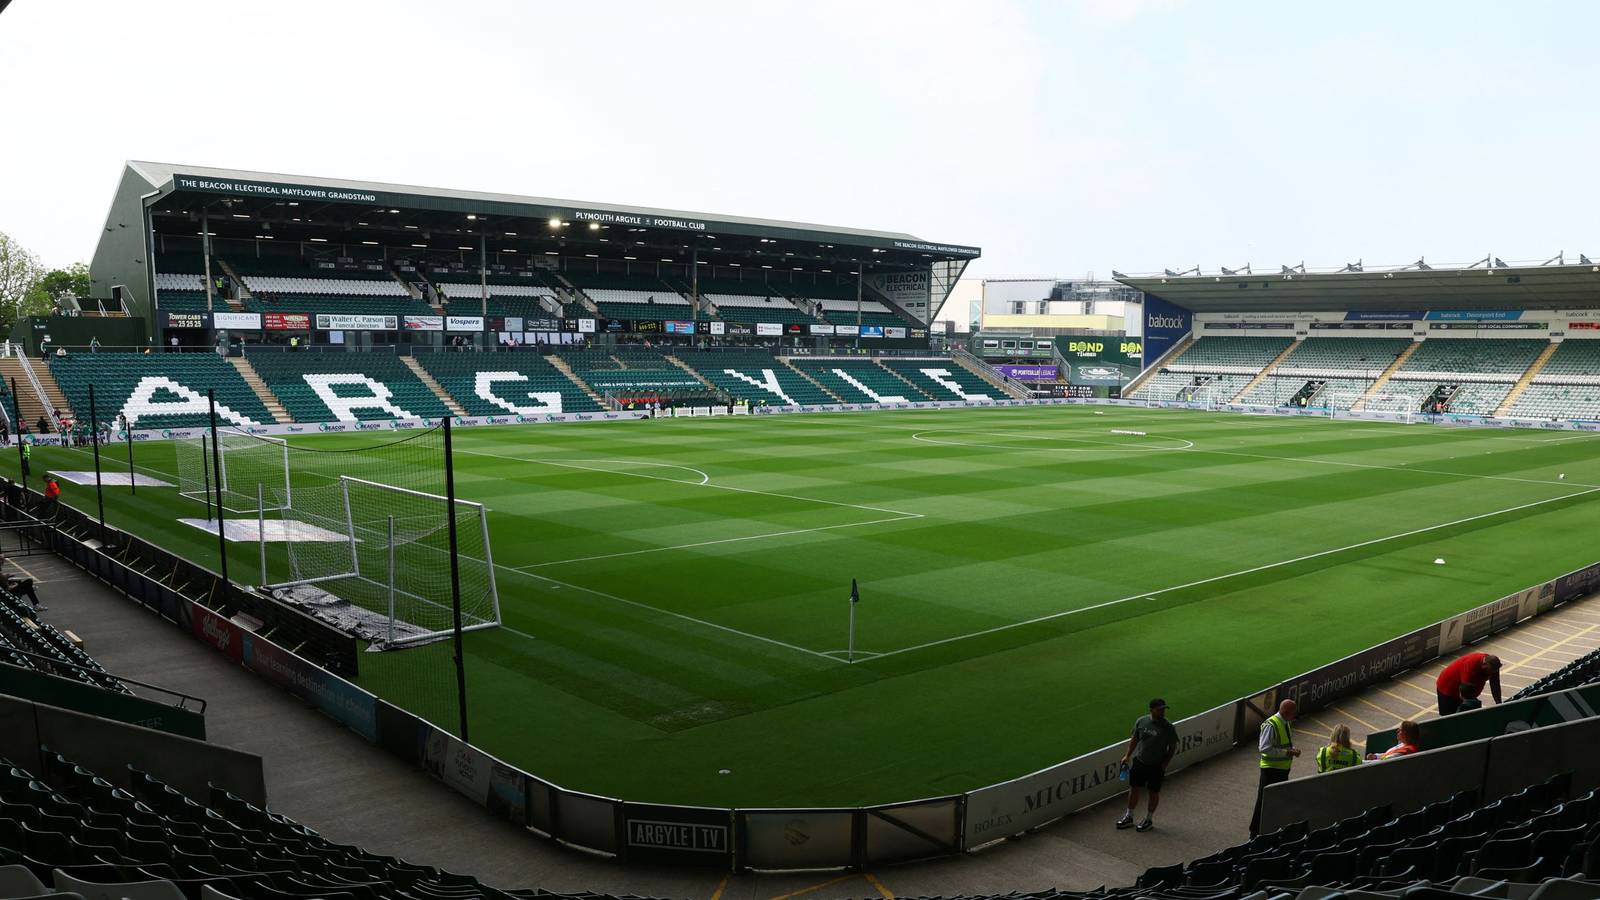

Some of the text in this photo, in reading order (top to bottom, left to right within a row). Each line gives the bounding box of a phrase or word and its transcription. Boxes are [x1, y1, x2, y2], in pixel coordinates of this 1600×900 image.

[180, 180, 376, 202] THE BEACON ELECTRICAL MAYFLOWER GRANDSTAND
[575, 211, 705, 230] PLYMOUTH ARGYLE FOOTBALL CLUB
[886, 273, 926, 284] BEACON
[886, 283, 926, 292] ELECTRICAL
[1148, 313, 1183, 328] babcock
[1068, 341, 1104, 352] BOND
[1120, 342, 1142, 353] BON
[270, 658, 297, 684] learning
[1312, 672, 1357, 701] Bathroom
[1359, 664, 1368, 680] &
[1369, 653, 1401, 676] Heating
[1205, 730, 1230, 746] ROLEX
[974, 814, 1013, 834] ROLEX
[636, 823, 719, 848] ARGYLE TV
